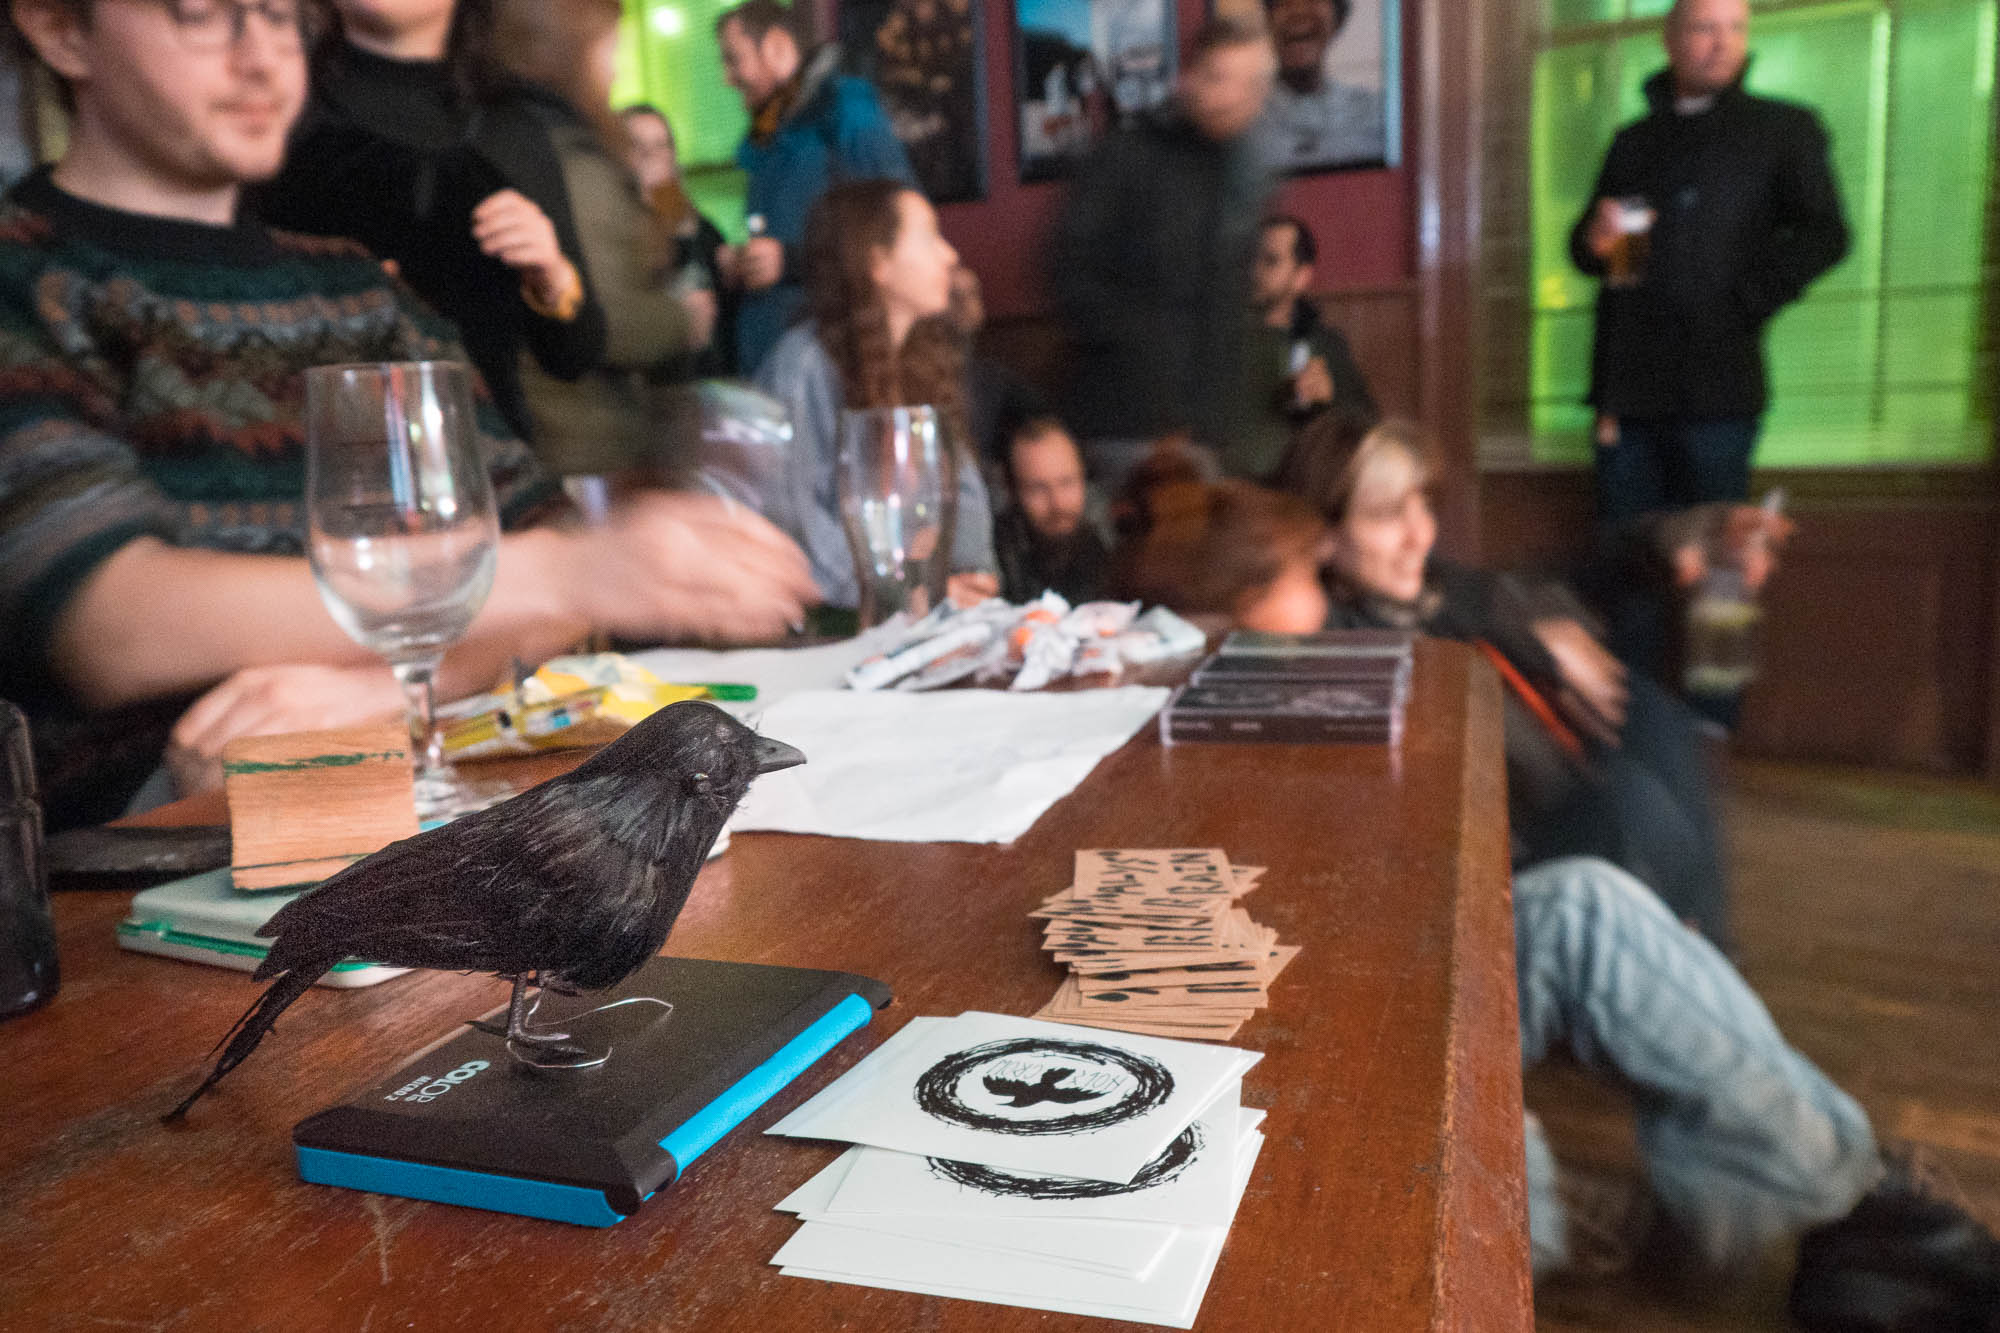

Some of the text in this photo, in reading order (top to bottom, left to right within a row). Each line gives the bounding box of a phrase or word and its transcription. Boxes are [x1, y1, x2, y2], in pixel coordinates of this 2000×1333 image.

[1167, 853, 1230, 895] RAIN
[393, 1075, 432, 1096] MICRO
[1072, 1068, 1128, 1091] HOLY
